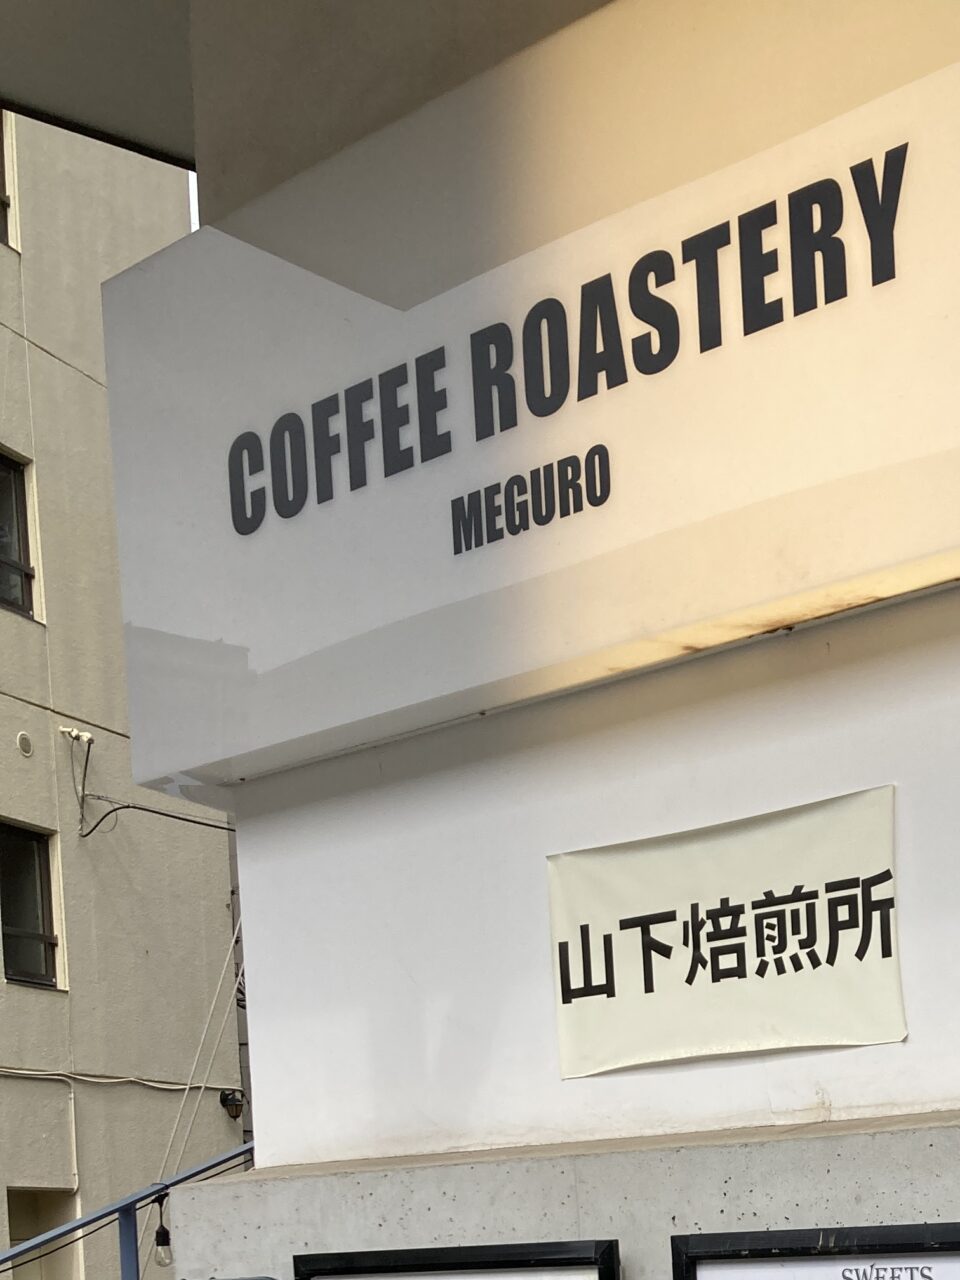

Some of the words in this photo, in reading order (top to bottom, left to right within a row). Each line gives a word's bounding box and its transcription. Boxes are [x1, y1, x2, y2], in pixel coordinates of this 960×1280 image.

[228, 346, 452, 536] COFFEE
[469, 142, 908, 442] ROASTERY
[451, 444, 611, 555] MEGURO
[558, 869, 895, 1004] 山下焙煎所
